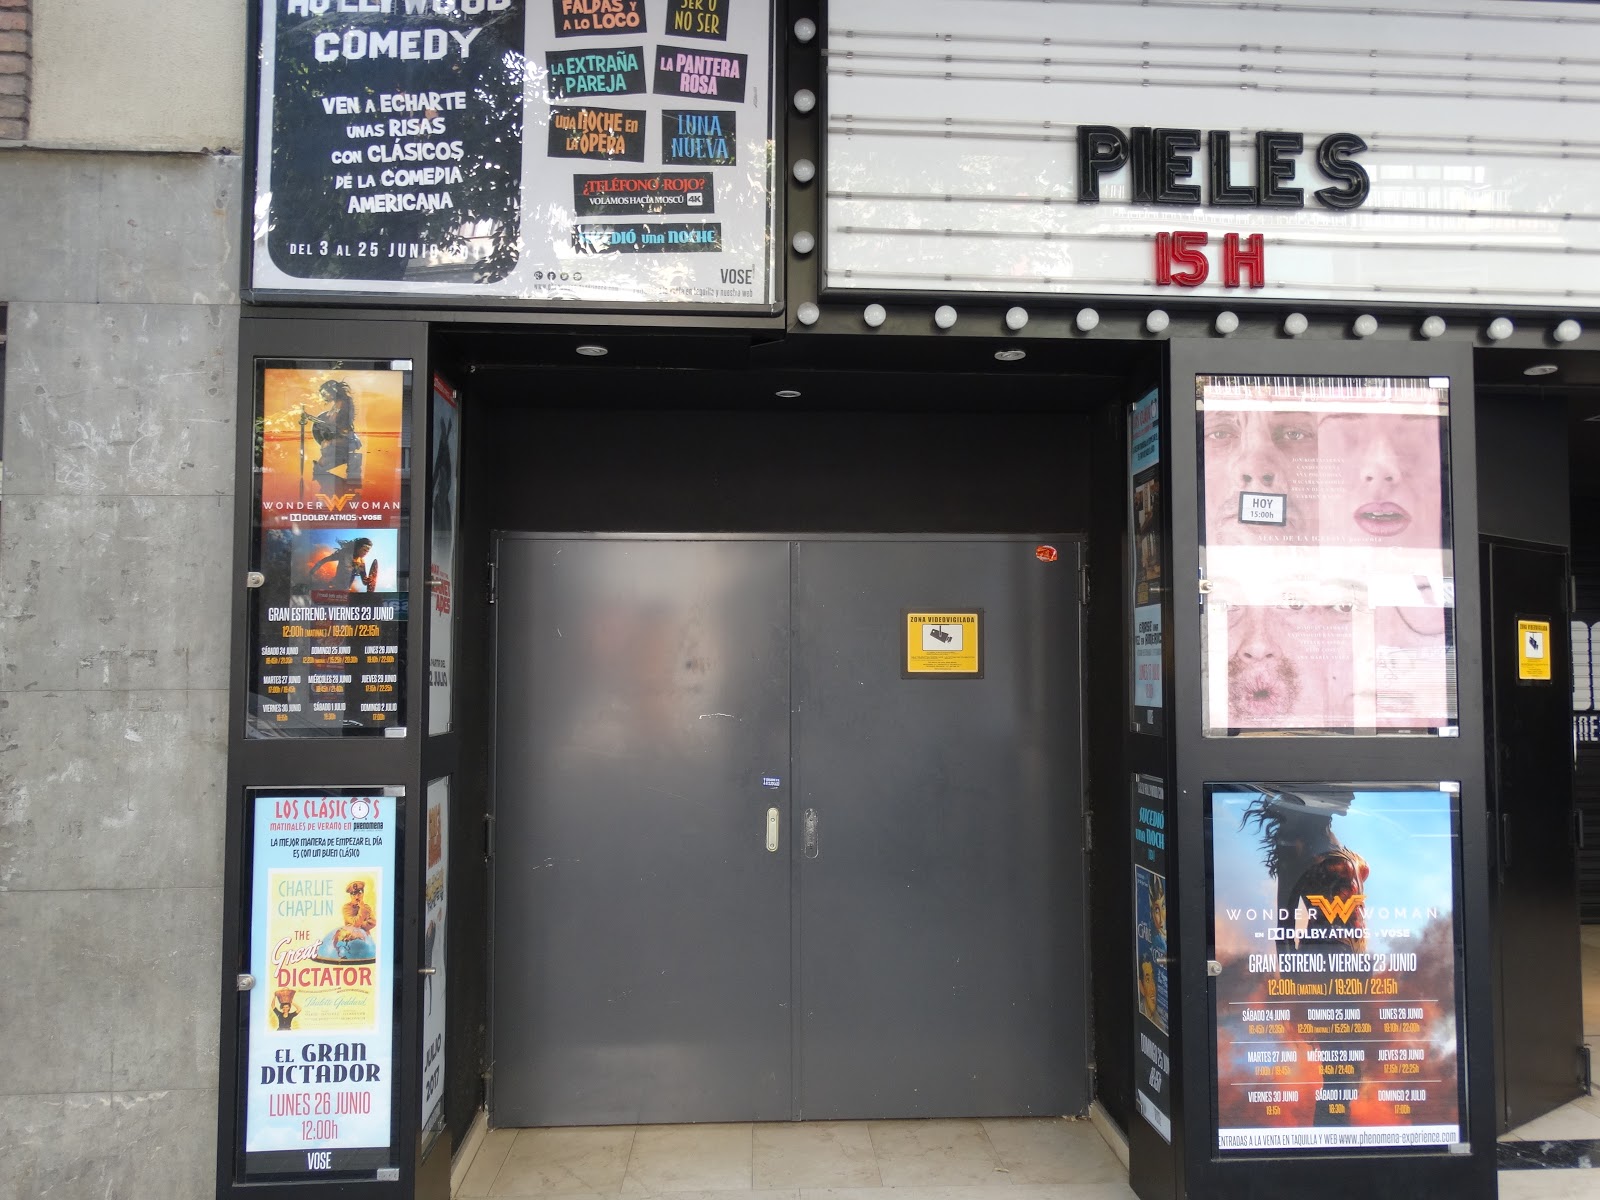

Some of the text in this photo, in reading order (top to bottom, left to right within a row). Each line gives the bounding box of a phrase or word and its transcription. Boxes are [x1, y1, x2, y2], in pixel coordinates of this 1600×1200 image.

[629, 2, 636, 12] Y
[563, 12, 640, 30] A LO LOCO
[674, 11, 720, 34] NO SER
[314, 28, 483, 63] COMEDY
[551, 51, 639, 75] LA EXTRAÑA
[660, 53, 740, 79] LA PANTERA
[565, 74, 627, 93] PAREJA
[680, 74, 718, 95] ROSA
[322, 91, 466, 115] VEN A ECHARTE
[346, 117, 446, 138] UNAS RISAS
[677, 114, 722, 136] LUNA
[331, 139, 464, 164] CON CLÁSICOS
[566, 138, 578, 151] LA
[672, 137, 729, 160] NUEVA
[1076, 125, 1371, 209] PIELES
[335, 166, 463, 189] DE LA COMEDIA
[583, 178, 705, 196] ¿TELÉFONO ROJO?
[347, 192, 453, 214] AMERICANA
[589, 196, 629, 206] VOLAMOS
[654, 193, 684, 204] MOSCÚ
[688, 195, 702, 203] 4K
[289, 243, 312, 255] DEL
[319, 240, 329, 256] 3
[336, 244, 351, 257] AL
[358, 242, 379, 257] 25
[388, 242, 438, 259] JUNIO
[720, 268, 753, 285] VOSE
[263, 501, 401, 510] WONDER WOMAN
[1252, 498, 1273, 509] HOY
[1250, 511, 1274, 519] 15:00h
[268, 606, 394, 621] GRAN ESTRENO: VIERNES 23 JUNIO
[275, 800, 299, 820] LOS
[307, 822, 315, 831] DE
[270, 838, 278, 847] LA
[327, 838, 335, 847] DE
[336, 837, 364, 847] EMPEZAR
[365, 838, 371, 846] EL
[372, 836, 383, 846] DÍA
[278, 879, 333, 898] CHARLIE
[278, 899, 333, 917] CHAPLIN
[1226, 907, 1438, 921] WONDER WOMAN
[294, 930, 310, 941] THE
[1286, 929, 1327, 939] DOLBY
[1329, 928, 1370, 939] ATMOS
[1381, 929, 1410, 938] VOSE
[1249, 953, 1417, 973] GRAN ESTRENO: VIERNES 23 JUNIO
[277, 967, 372, 988] DICTATOR
[1268, 979, 1296, 996] 12:00h
[1334, 979, 1362, 995] 19:20h
[1371, 978, 1398, 995] 22:15h
[1242, 1008, 1265, 1021] SÁBADO
[1265, 1010, 1273, 1021] 24
[1274, 1009, 1290, 1021] JUNIO
[1307, 1009, 1334, 1020] DOMINGO
[1336, 1009, 1343, 1020] 25
[1344, 1009, 1360, 1020] JUNIO
[1379, 1008, 1397, 1020] LUNES
[1407, 1008, 1424, 1020] JUNIO
[275, 1043, 367, 1063] EL GRAN
[1248, 1051, 1271, 1062] MARTES
[1272, 1051, 1280, 1062] 27
[1281, 1051, 1297, 1062] JUNIO
[1307, 1049, 1338, 1062] MIÉRCOLES
[1349, 1050, 1365, 1061] JUNIO
[1378, 1049, 1399, 1061] JUEVES
[1408, 1049, 1424, 1060] JUNIO
[261, 1063, 381, 1085] DICTADOR
[269, 1091, 371, 1116] LUNES 26 JUNIO
[1248, 1091, 1272, 1103] VIERNES
[1282, 1091, 1298, 1102] JUNIO
[1315, 1088, 1338, 1101] SÁBADO
[1343, 1089, 1358, 1100] JULIO
[1378, 1090, 1404, 1101] DOMINGO
[1405, 1090, 1410, 1101] 2
[1411, 1090, 1426, 1101] JULIO
[301, 1120, 338, 1140] 12:00h
[1219, 1135, 1247, 1147] ENTRADAS
[1249, 1136, 1253, 1146] A
[1254, 1135, 1261, 1146] LA
[1262, 1135, 1280, 1146] VENTA
[1282, 1135, 1290, 1145] EN
[1291, 1134, 1317, 1146] TAQUILLA
[1324, 1134, 1337, 1144] WEB
[1339, 1130, 1457, 1147] www.phenomena-experience.com
[307, 1152, 331, 1170] VOSE
